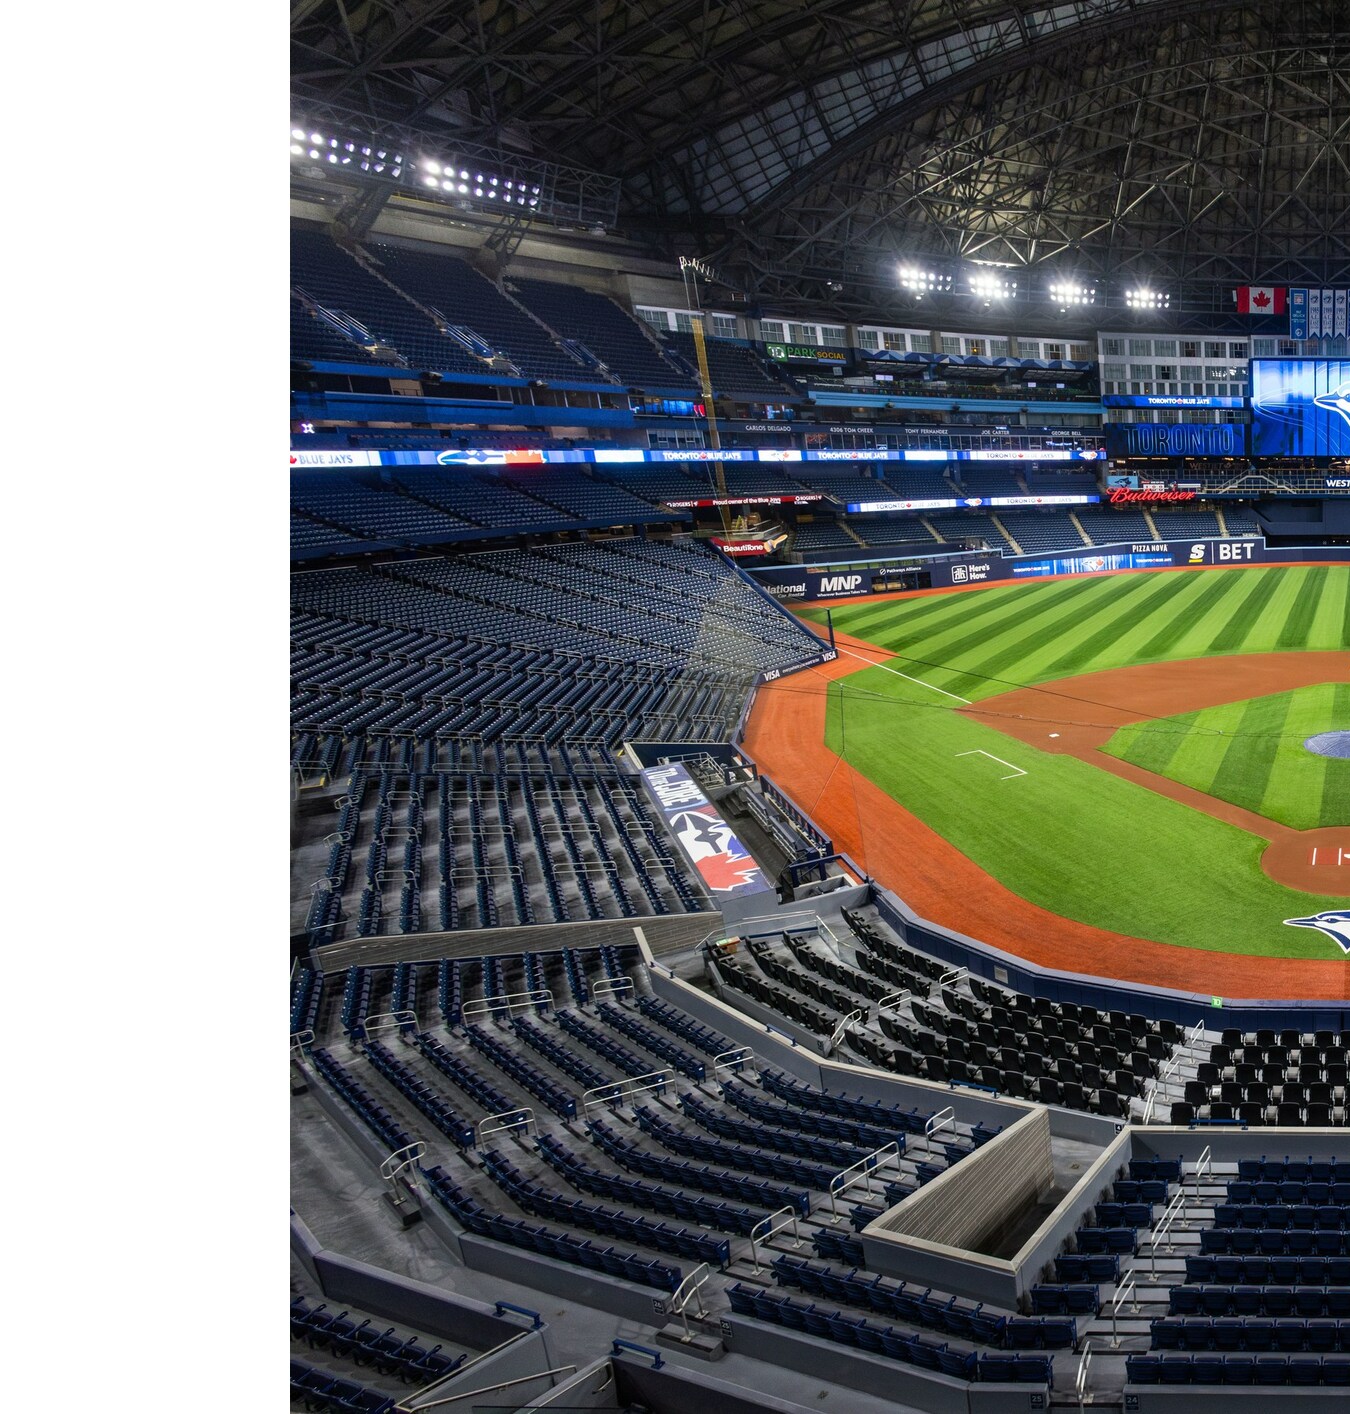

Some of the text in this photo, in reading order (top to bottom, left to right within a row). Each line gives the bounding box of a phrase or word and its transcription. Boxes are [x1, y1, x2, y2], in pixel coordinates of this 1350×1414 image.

[768, 346, 846, 360] TD PARK SOCIAL
[1124, 424, 1234, 455] TORONTO
[299, 455, 353, 464] BLUE JAYS
[663, 452, 700, 460] TORONTO
[1106, 487, 1196, 502] Budweiser
[724, 544, 763, 552] BeautiTone
[1151, 544, 1168, 552] NOVA
[1219, 543, 1254, 560] BET
[969, 564, 990, 572] Here's
[970, 572, 987, 580] How.
[820, 575, 862, 592] MNP
[763, 669, 780, 681] VISA
[822, 651, 836, 661] VISA
[653, 780, 705, 807] CORE
